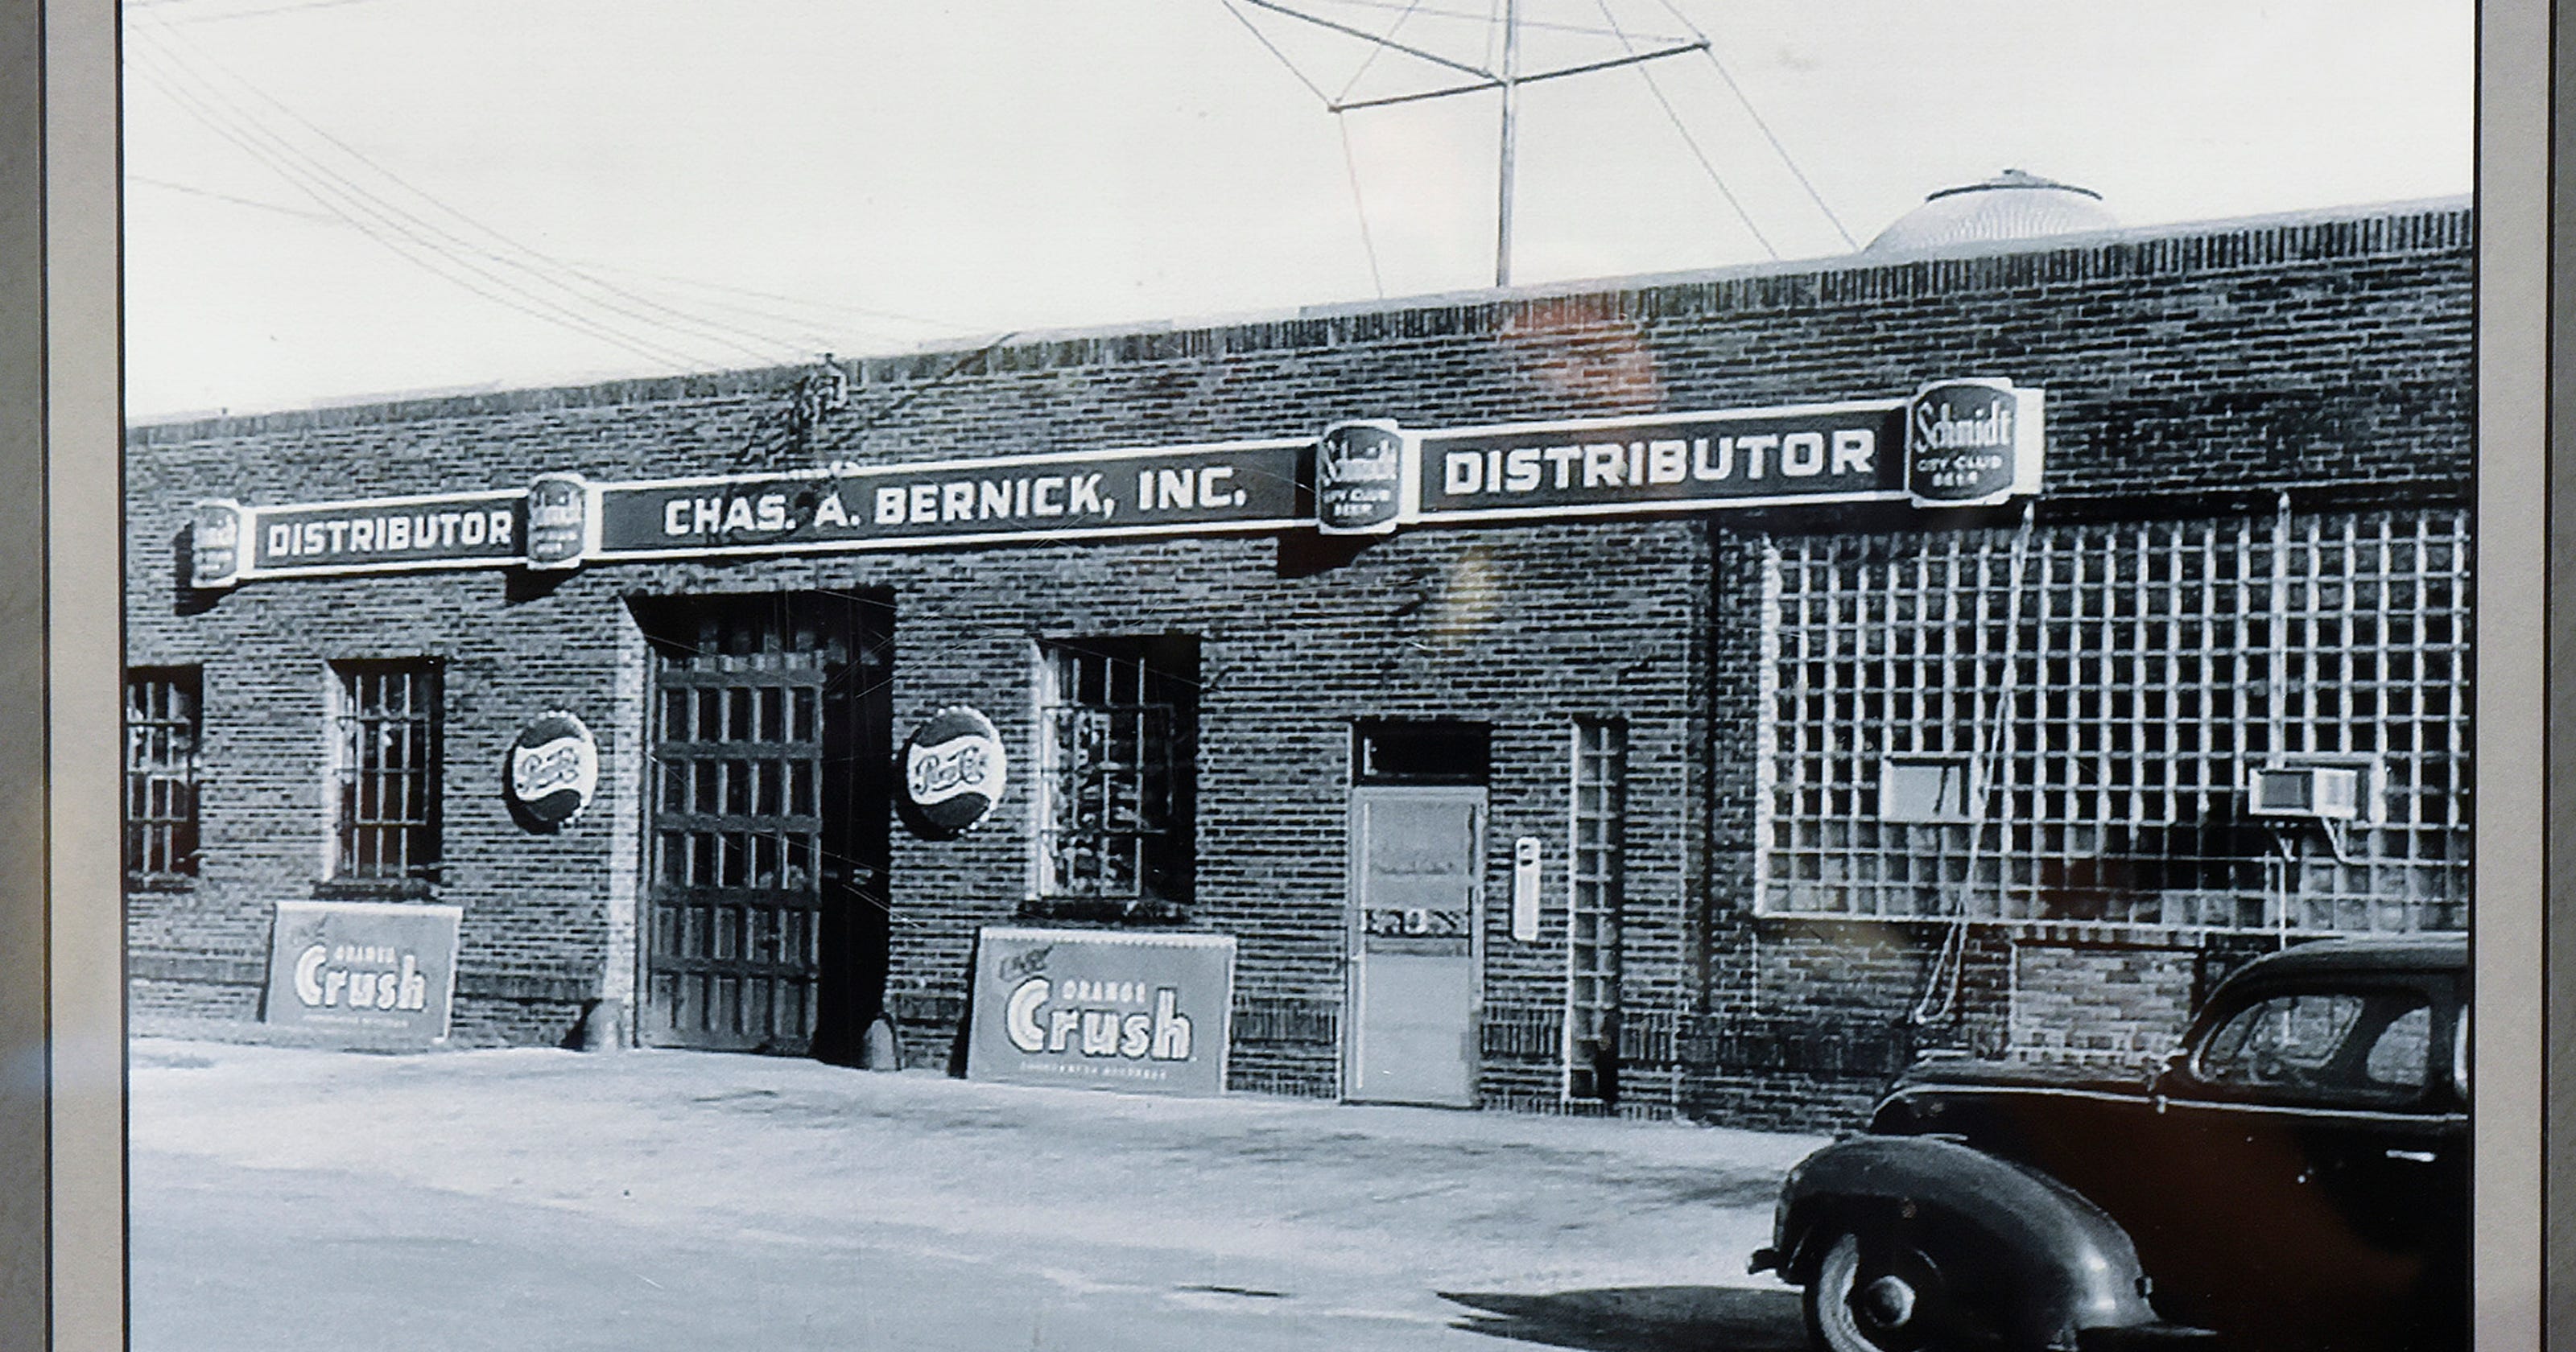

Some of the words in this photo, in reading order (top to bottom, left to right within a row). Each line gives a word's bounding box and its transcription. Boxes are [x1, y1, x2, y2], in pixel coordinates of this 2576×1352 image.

[1914, 400, 2013, 453] Schmidt
[1444, 428, 1876, 496] DISTRIBUTOR
[266, 509, 514, 558] DISTRIBUTOR
[663, 494, 795, 537] CHAS.
[812, 491, 861, 529] A.
[873, 472, 1116, 527] BERNICK,
[1137, 465, 1247, 510] INC.
[295, 944, 426, 1011] Crush
[1005, 975, 1194, 1061] Crush
